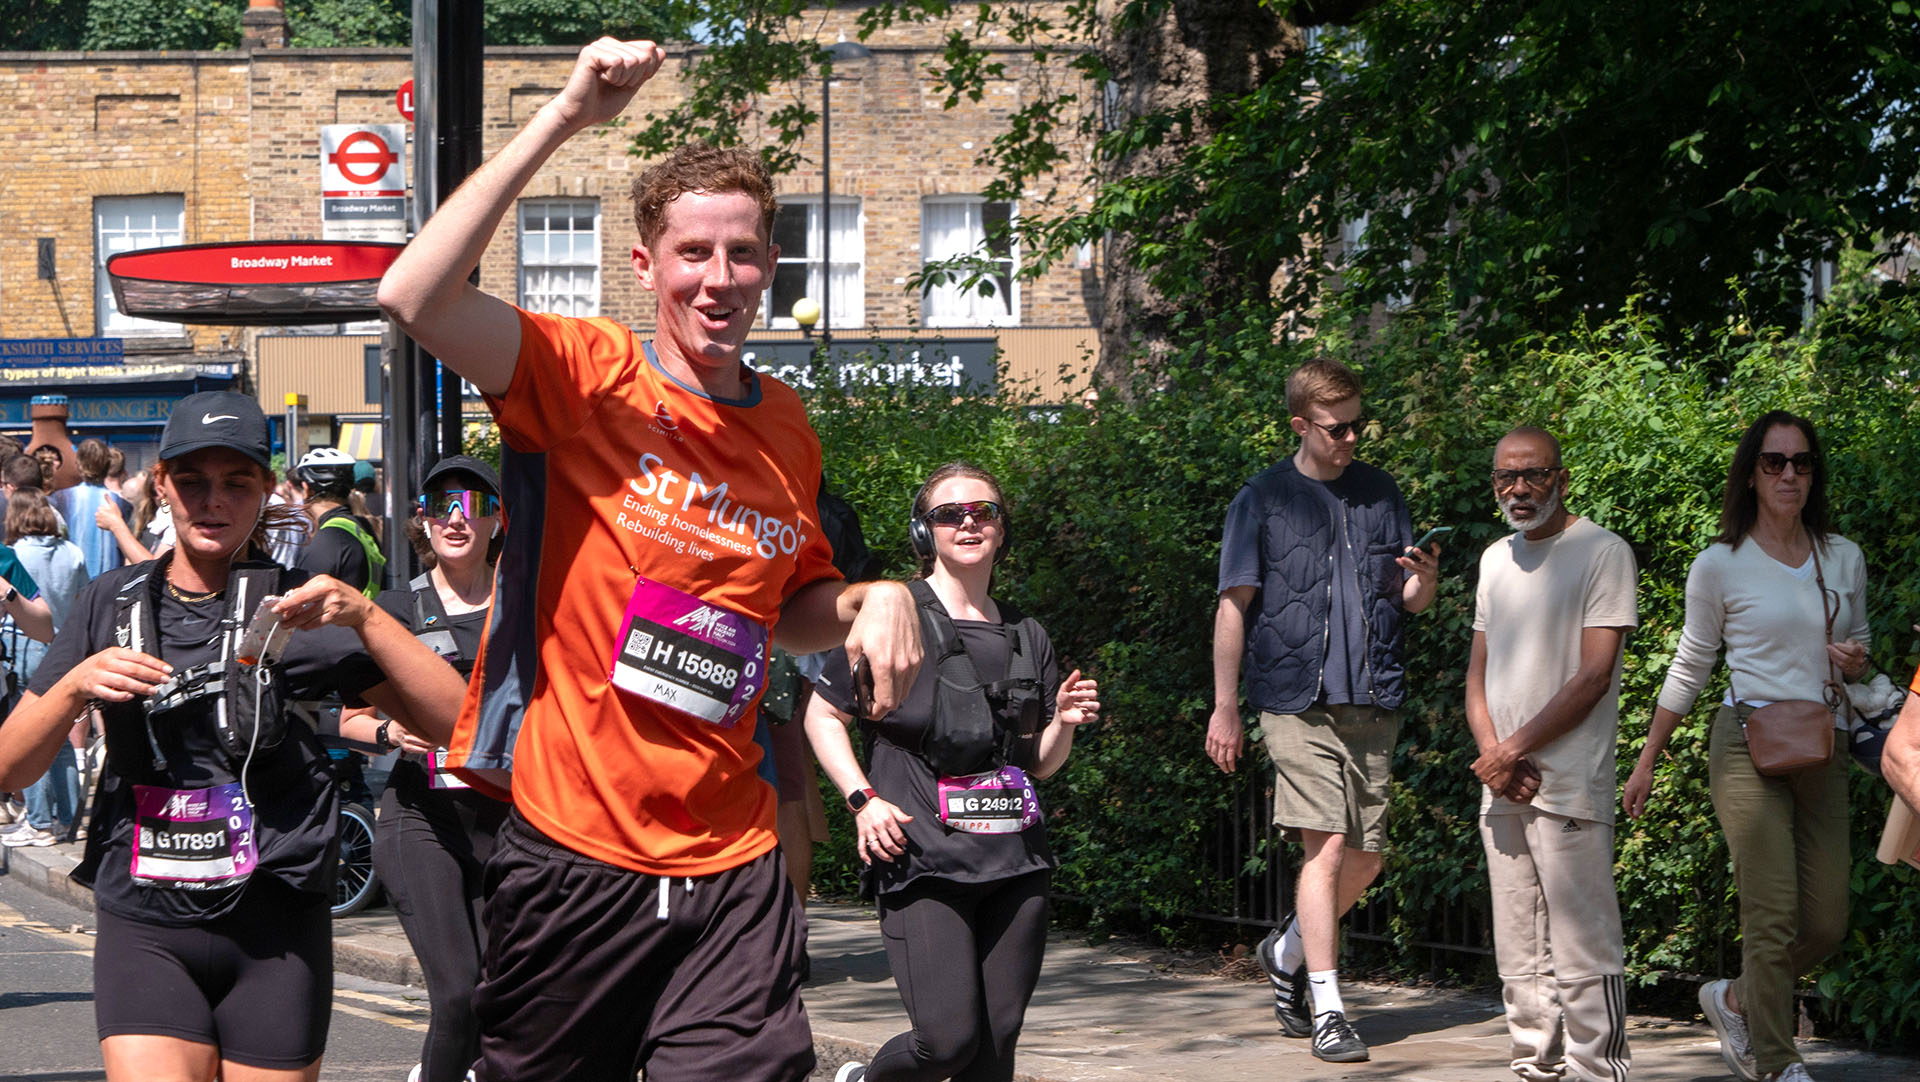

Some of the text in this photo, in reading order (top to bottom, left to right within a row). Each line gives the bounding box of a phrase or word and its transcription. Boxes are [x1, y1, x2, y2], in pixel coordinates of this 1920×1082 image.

[331, 204, 396, 214] Broadway Market
[231, 255, 333, 270] Broadway Market
[58, 341, 121, 354] SERVICES
[3, 368, 39, 381] types
[41, 367, 55, 378] of
[57, 366, 87, 379] light
[125, 364, 153, 376] sold
[629, 452, 679, 505] St
[622, 494, 752, 557] Ending homelessness
[616, 511, 715, 562] Rebuilding lives
[652, 640, 674, 665] H
[677, 650, 738, 690] 15988
[653, 683, 678, 702] MAX
[965, 797, 1023, 812] G 24912
[952, 821, 991, 831] PIPPA
